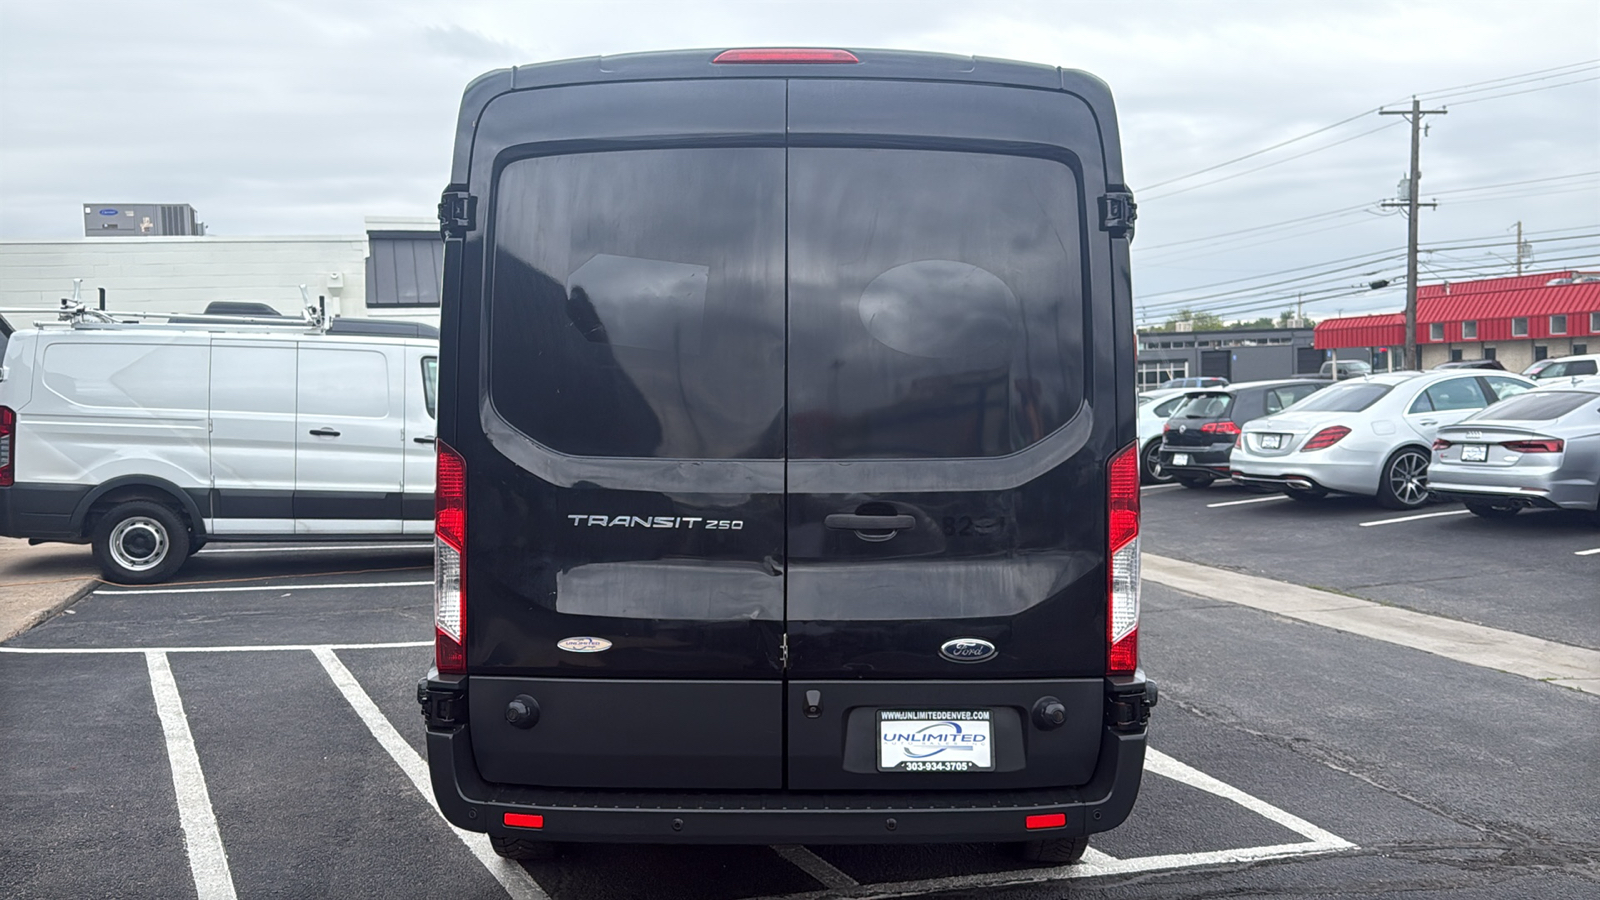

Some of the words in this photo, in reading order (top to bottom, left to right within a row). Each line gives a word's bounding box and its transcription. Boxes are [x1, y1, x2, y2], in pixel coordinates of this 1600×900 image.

[567, 514, 702, 529] TRANSIT
[705, 520, 744, 530] 250
[953, 642, 984, 656] Ford
[883, 733, 986, 742] UNLIMITED
[906, 762, 968, 771] 303-934-3705
